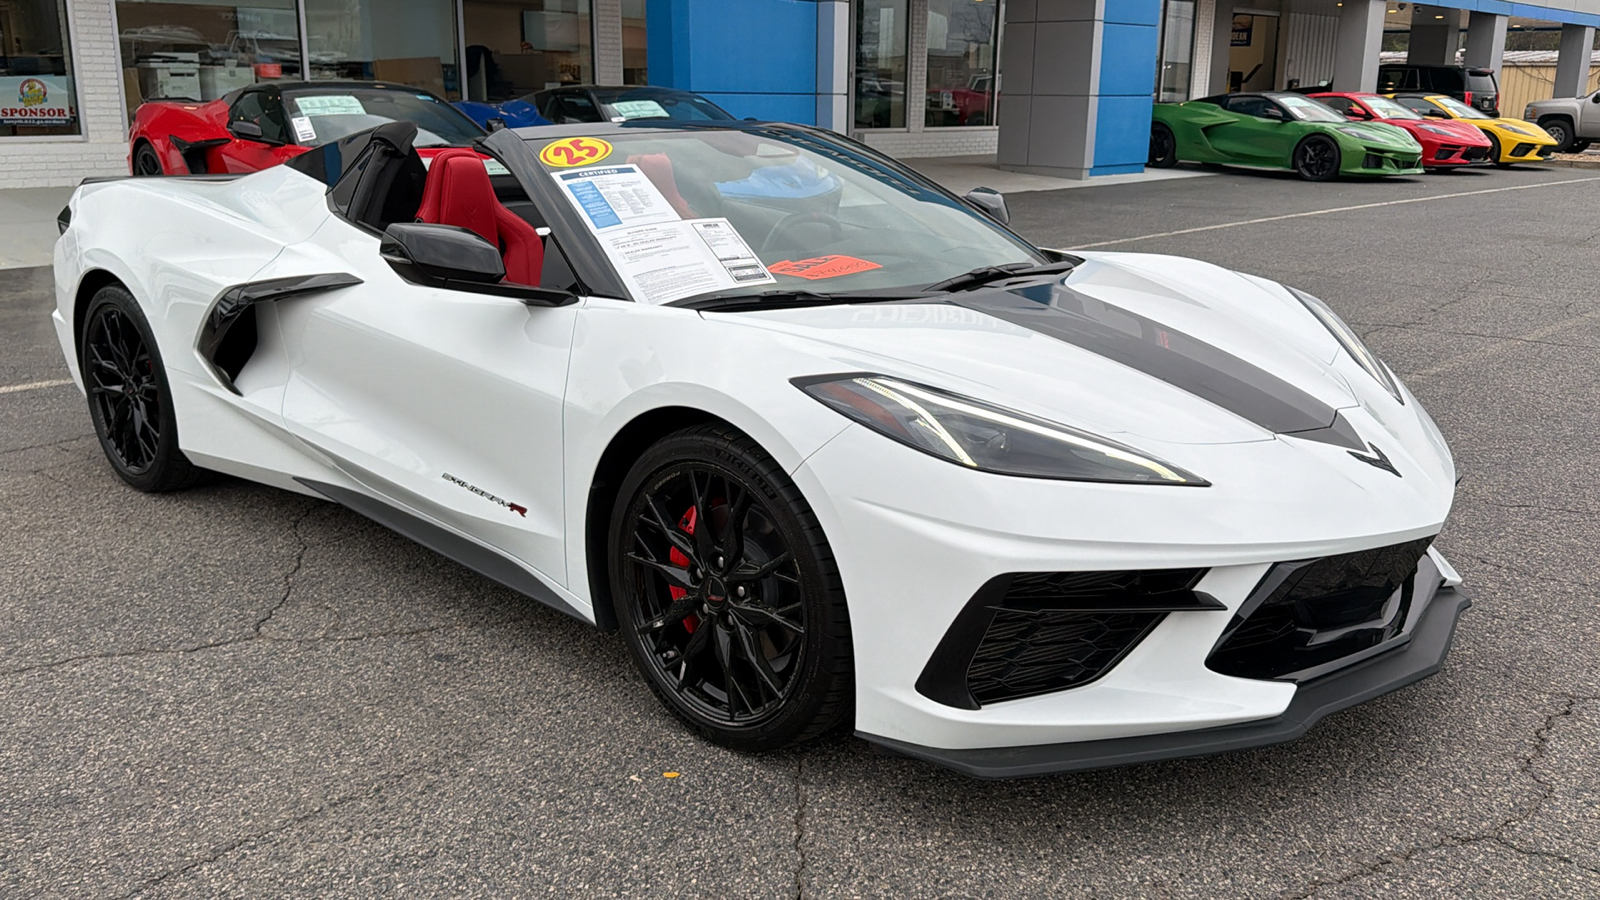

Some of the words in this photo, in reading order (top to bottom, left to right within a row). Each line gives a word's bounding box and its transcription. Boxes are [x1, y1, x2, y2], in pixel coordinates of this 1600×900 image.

[1, 107, 67, 117] SPONSOR
[553, 139, 598, 165] 25
[578, 169, 618, 177] CERTIFIED
[717, 450, 778, 500] MICHELIN
